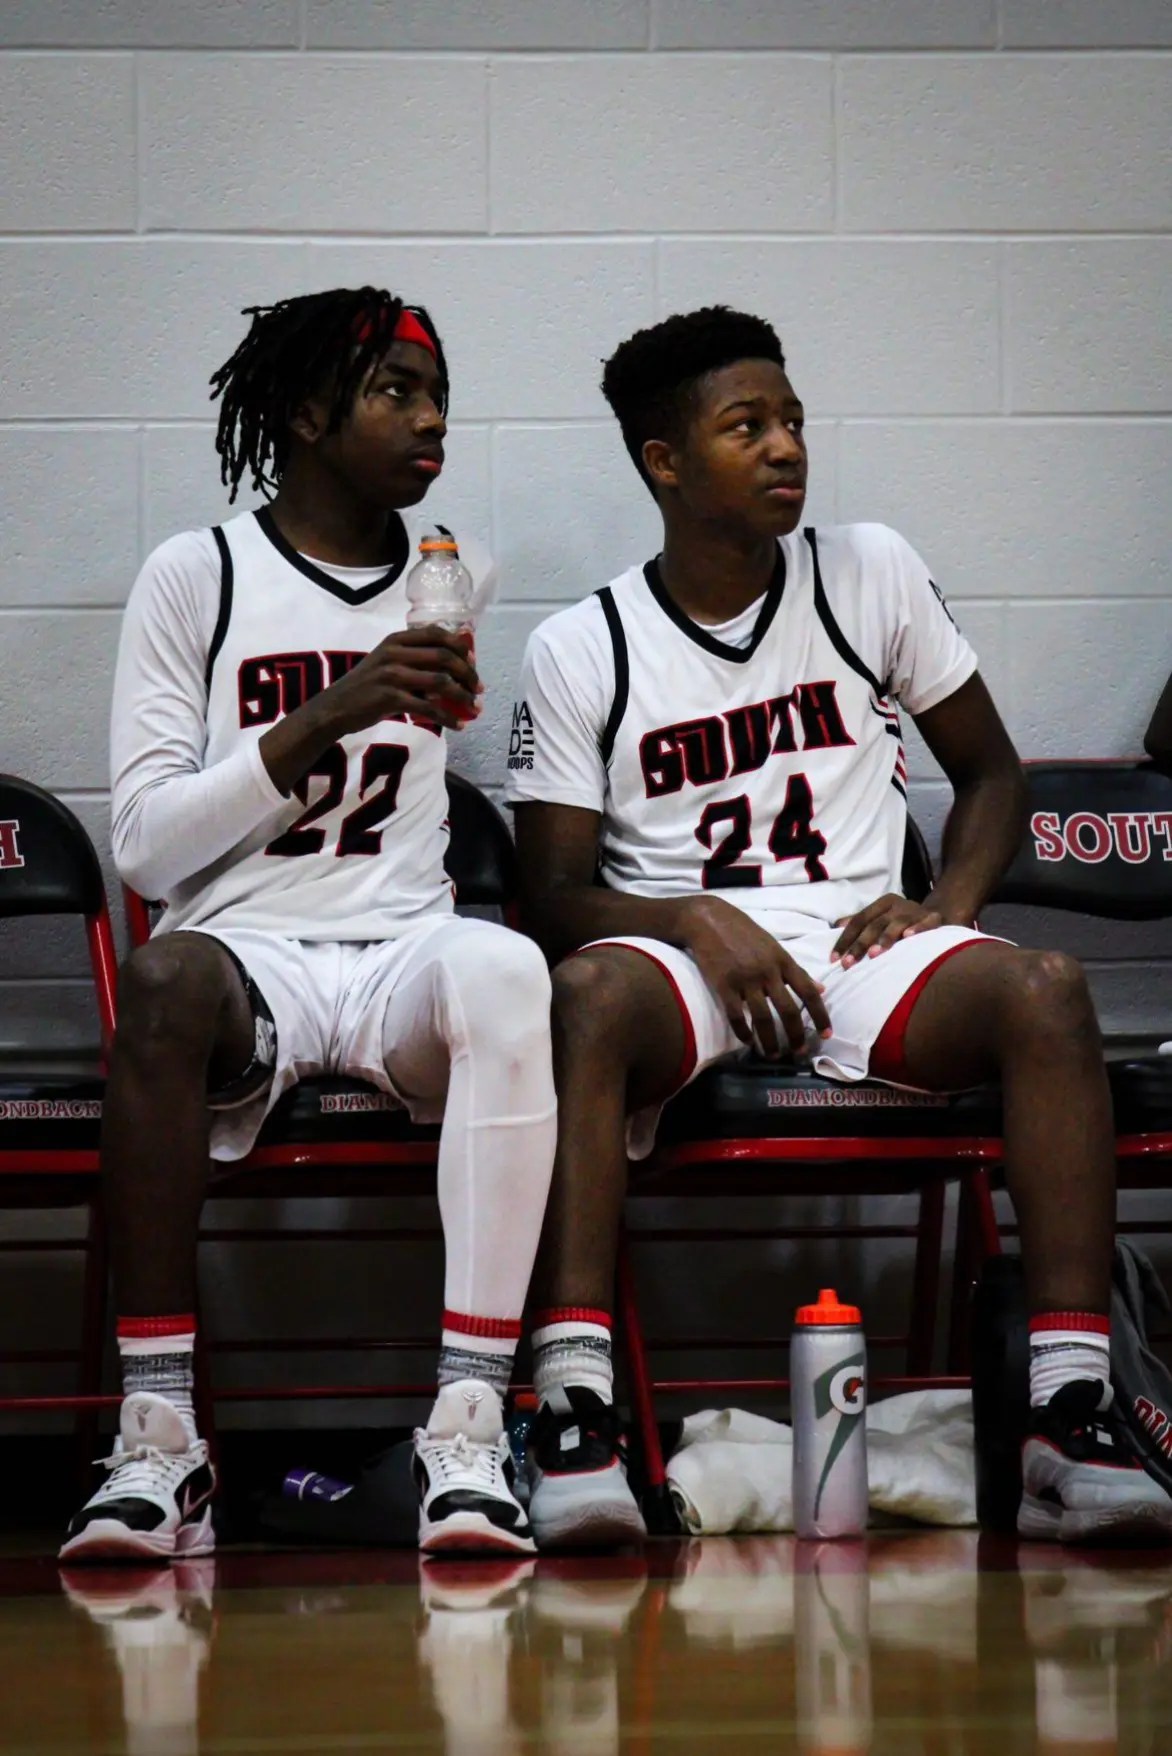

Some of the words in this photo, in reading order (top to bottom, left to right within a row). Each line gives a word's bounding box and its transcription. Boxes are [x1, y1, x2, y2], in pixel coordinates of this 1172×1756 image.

[639, 680, 857, 799] SOUTH
[264, 742, 410, 857] 22
[694, 772, 829, 889] 24
[829, 1365, 865, 1415] G
